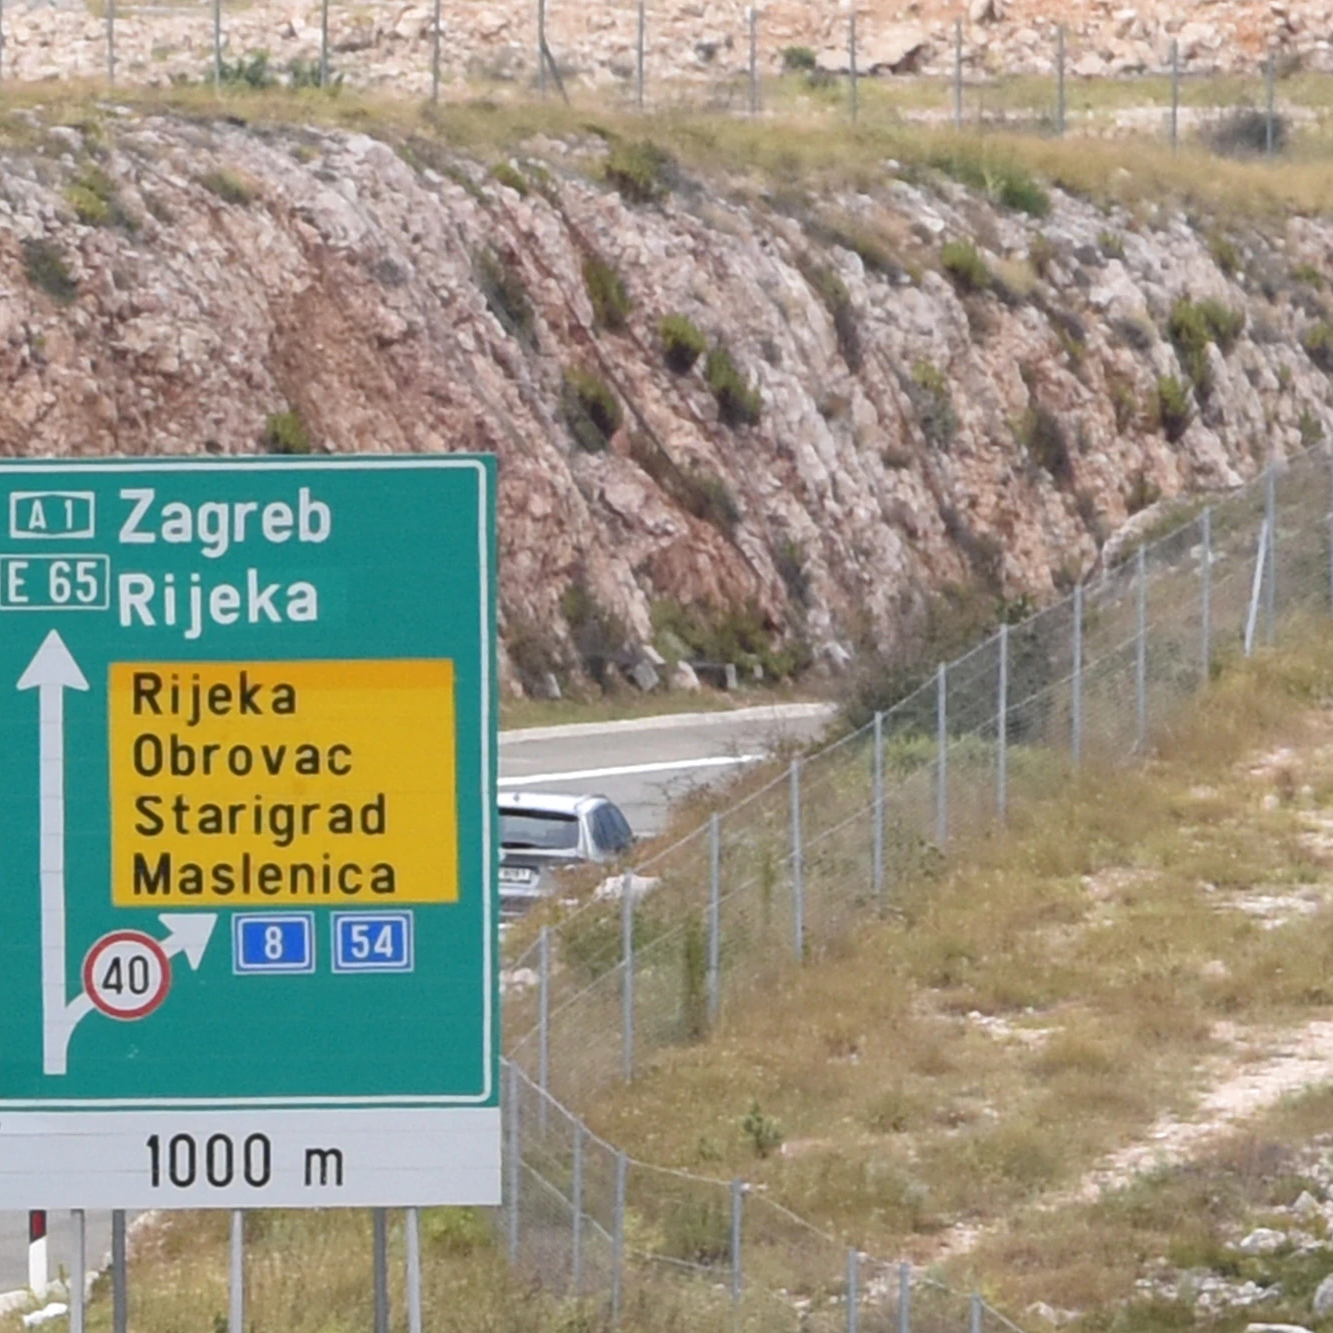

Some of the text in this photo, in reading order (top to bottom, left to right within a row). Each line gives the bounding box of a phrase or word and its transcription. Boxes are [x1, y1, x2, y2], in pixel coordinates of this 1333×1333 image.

[29, 499, 73, 530] A 1
[119, 487, 331, 559] Zagreb
[8, 560, 98, 603] E 65
[118, 568, 318, 639] Rijeka
[133, 670, 296, 727] Rijeka
[133, 733, 352, 777] Obrovac
[134, 793, 386, 847] Starigrad
[133, 852, 395, 895] Maslenica
[263, 925, 284, 960] 8
[350, 924, 394, 959] 54
[101, 955, 150, 994] 40
[146, 1132, 343, 1188] 1000 m
